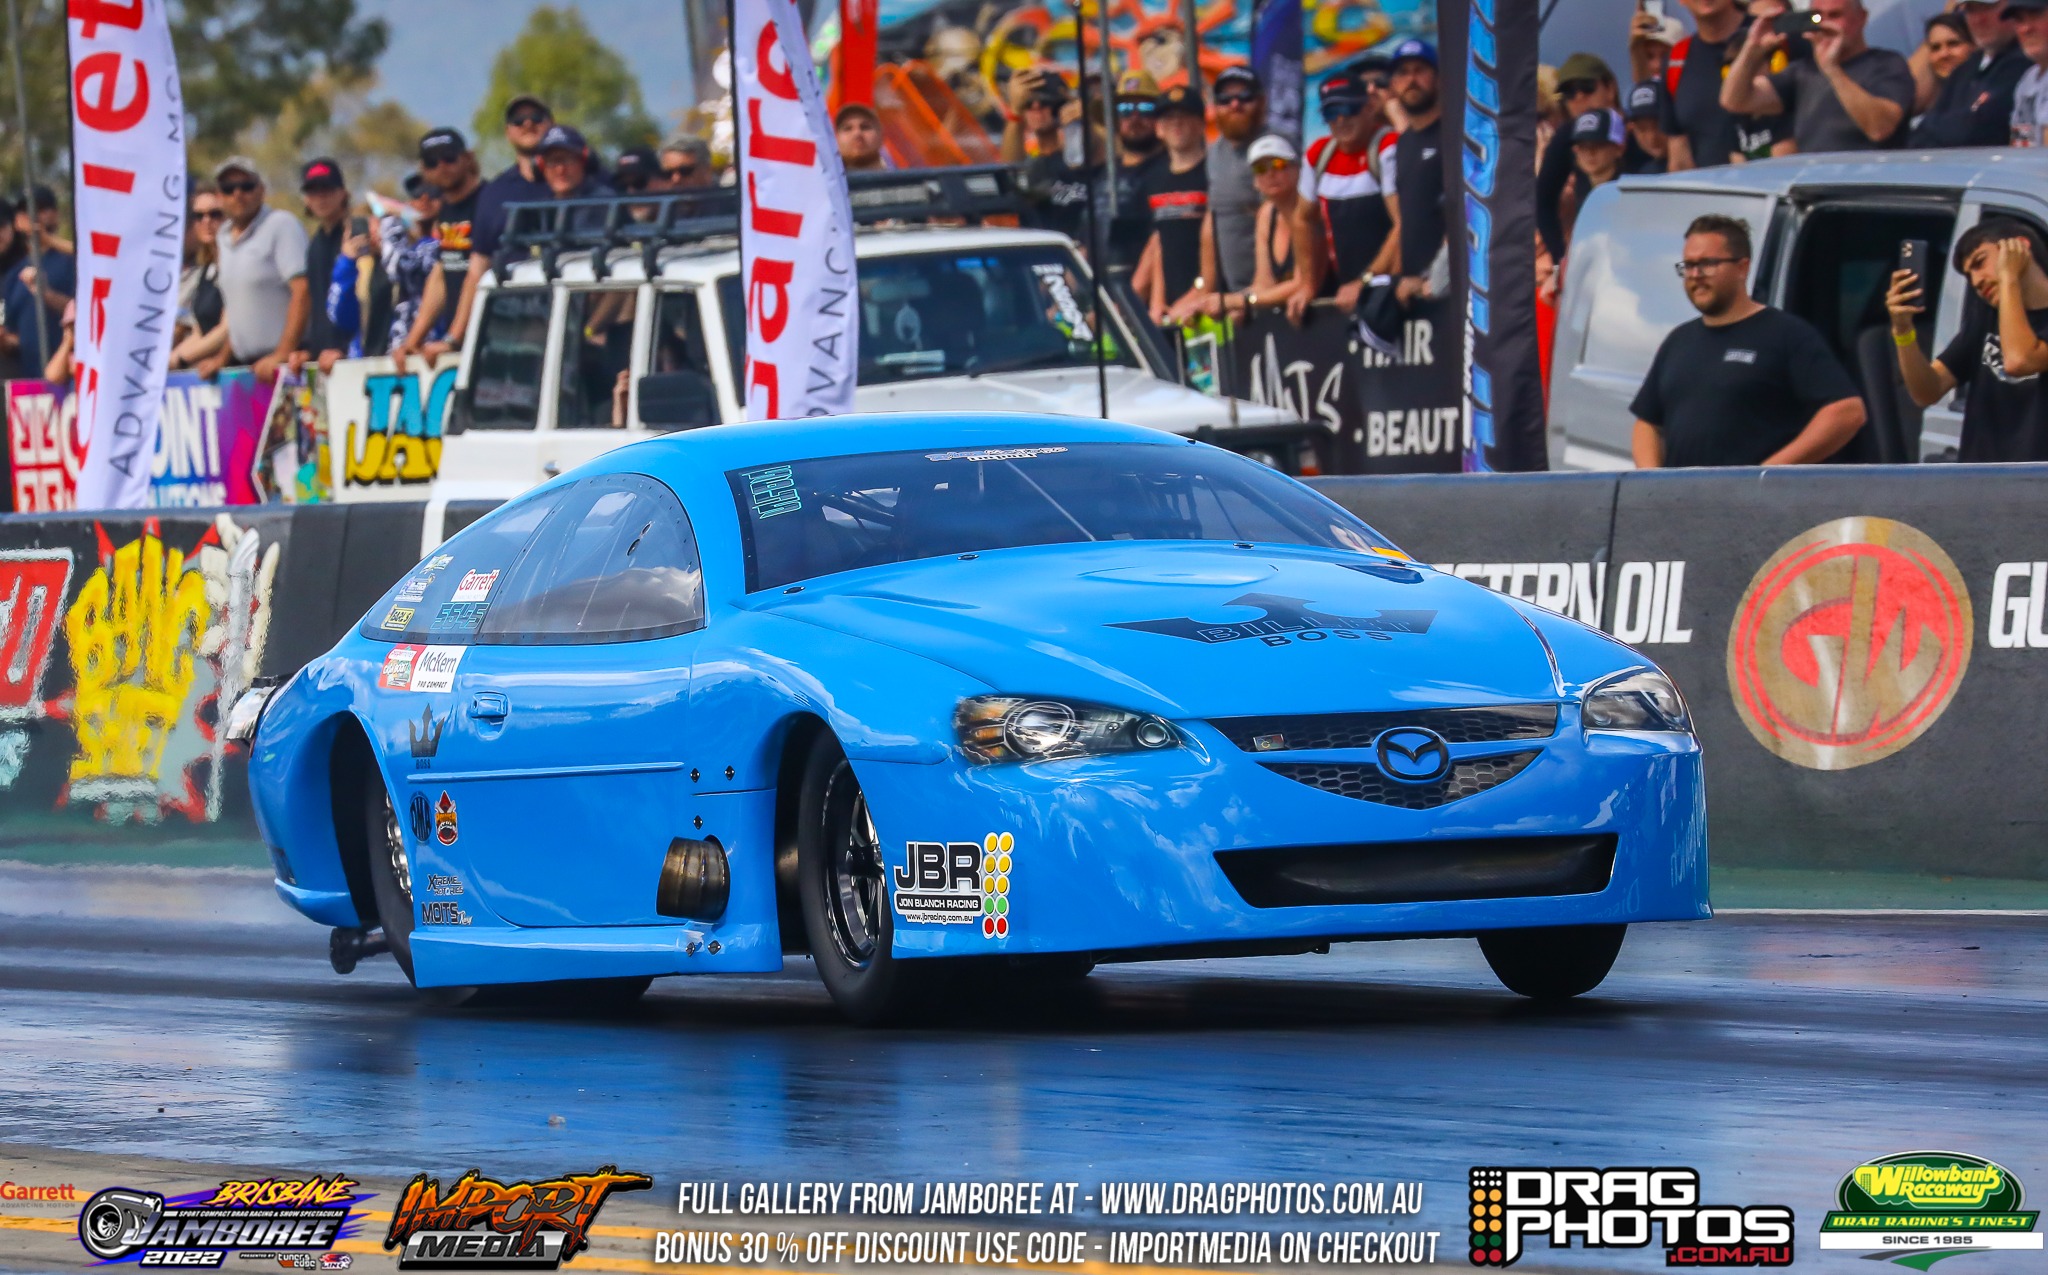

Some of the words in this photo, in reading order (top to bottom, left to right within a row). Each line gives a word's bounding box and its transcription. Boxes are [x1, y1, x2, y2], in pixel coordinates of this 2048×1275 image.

[108, 173, 180, 477] ADVANCING
[459, 569, 500, 591] Garrett
[1613, 560, 1693, 644] OIL
[1197, 617, 1411, 642] BILLET
[1258, 629, 1393, 647] BOSS
[894, 842, 982, 891] JBR
[421, 901, 459, 925] MOITS
[899, 898, 914, 908] JON
[915, 898, 945, 909] BLANCH
[947, 899, 979, 909] RACING
[906, 912, 973, 923] www.jbracing.com.au
